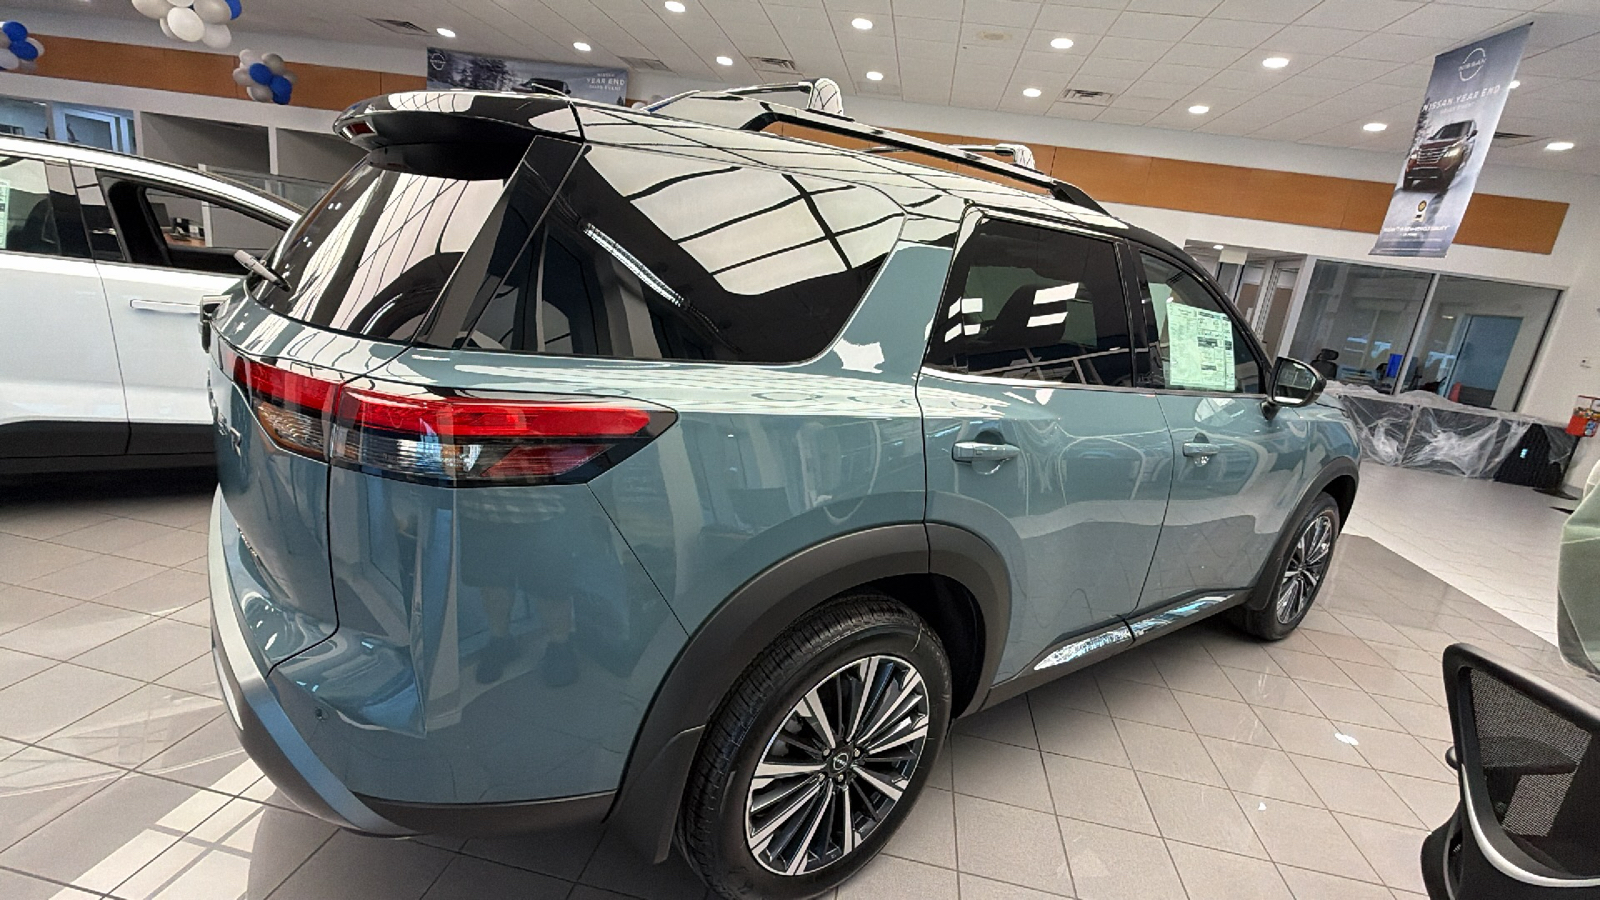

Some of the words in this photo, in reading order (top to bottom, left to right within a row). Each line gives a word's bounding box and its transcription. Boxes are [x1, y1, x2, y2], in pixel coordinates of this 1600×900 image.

[608, 78, 625, 86] END
[1421, 98, 1454, 111] NISSAN
[1456, 91, 1480, 103] YEAR
[1481, 84, 1501, 97] END
